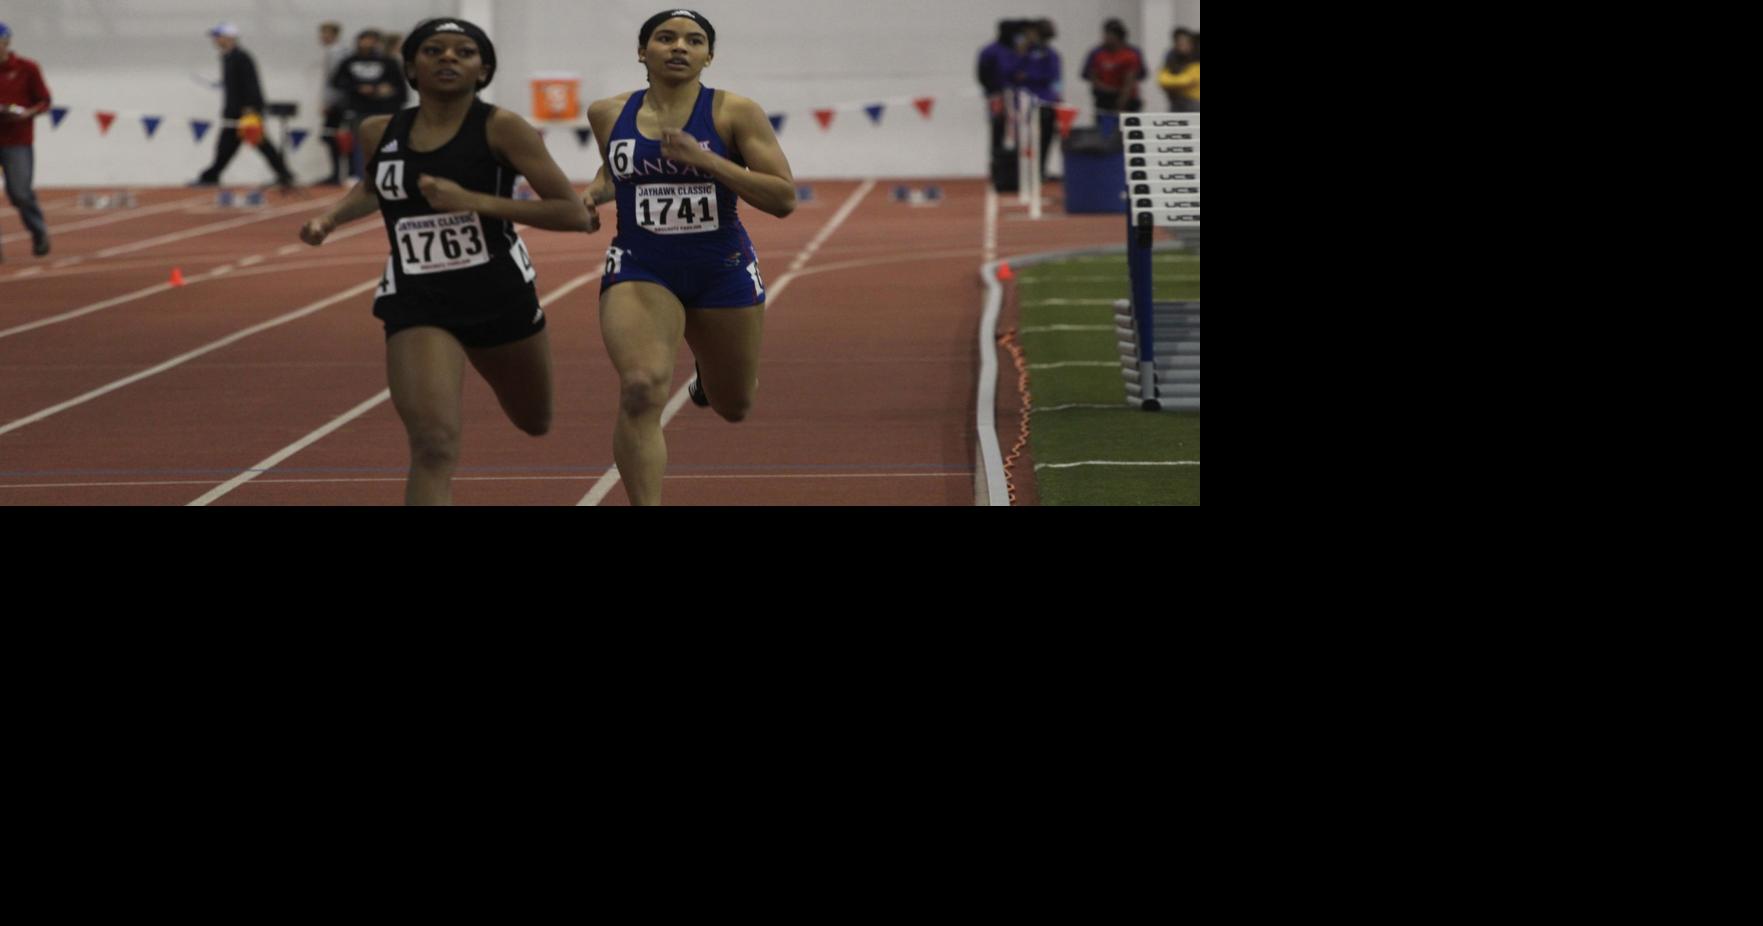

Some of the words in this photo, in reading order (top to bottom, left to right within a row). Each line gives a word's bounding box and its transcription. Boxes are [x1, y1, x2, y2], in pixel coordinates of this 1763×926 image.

[614, 141, 629, 173] 6
[381, 163, 399, 198] 4
[639, 186, 677, 197] JAYHAWK
[677, 185, 712, 195] CLASSIC
[639, 197, 714, 226] 1741
[401, 225, 483, 264] 1763
